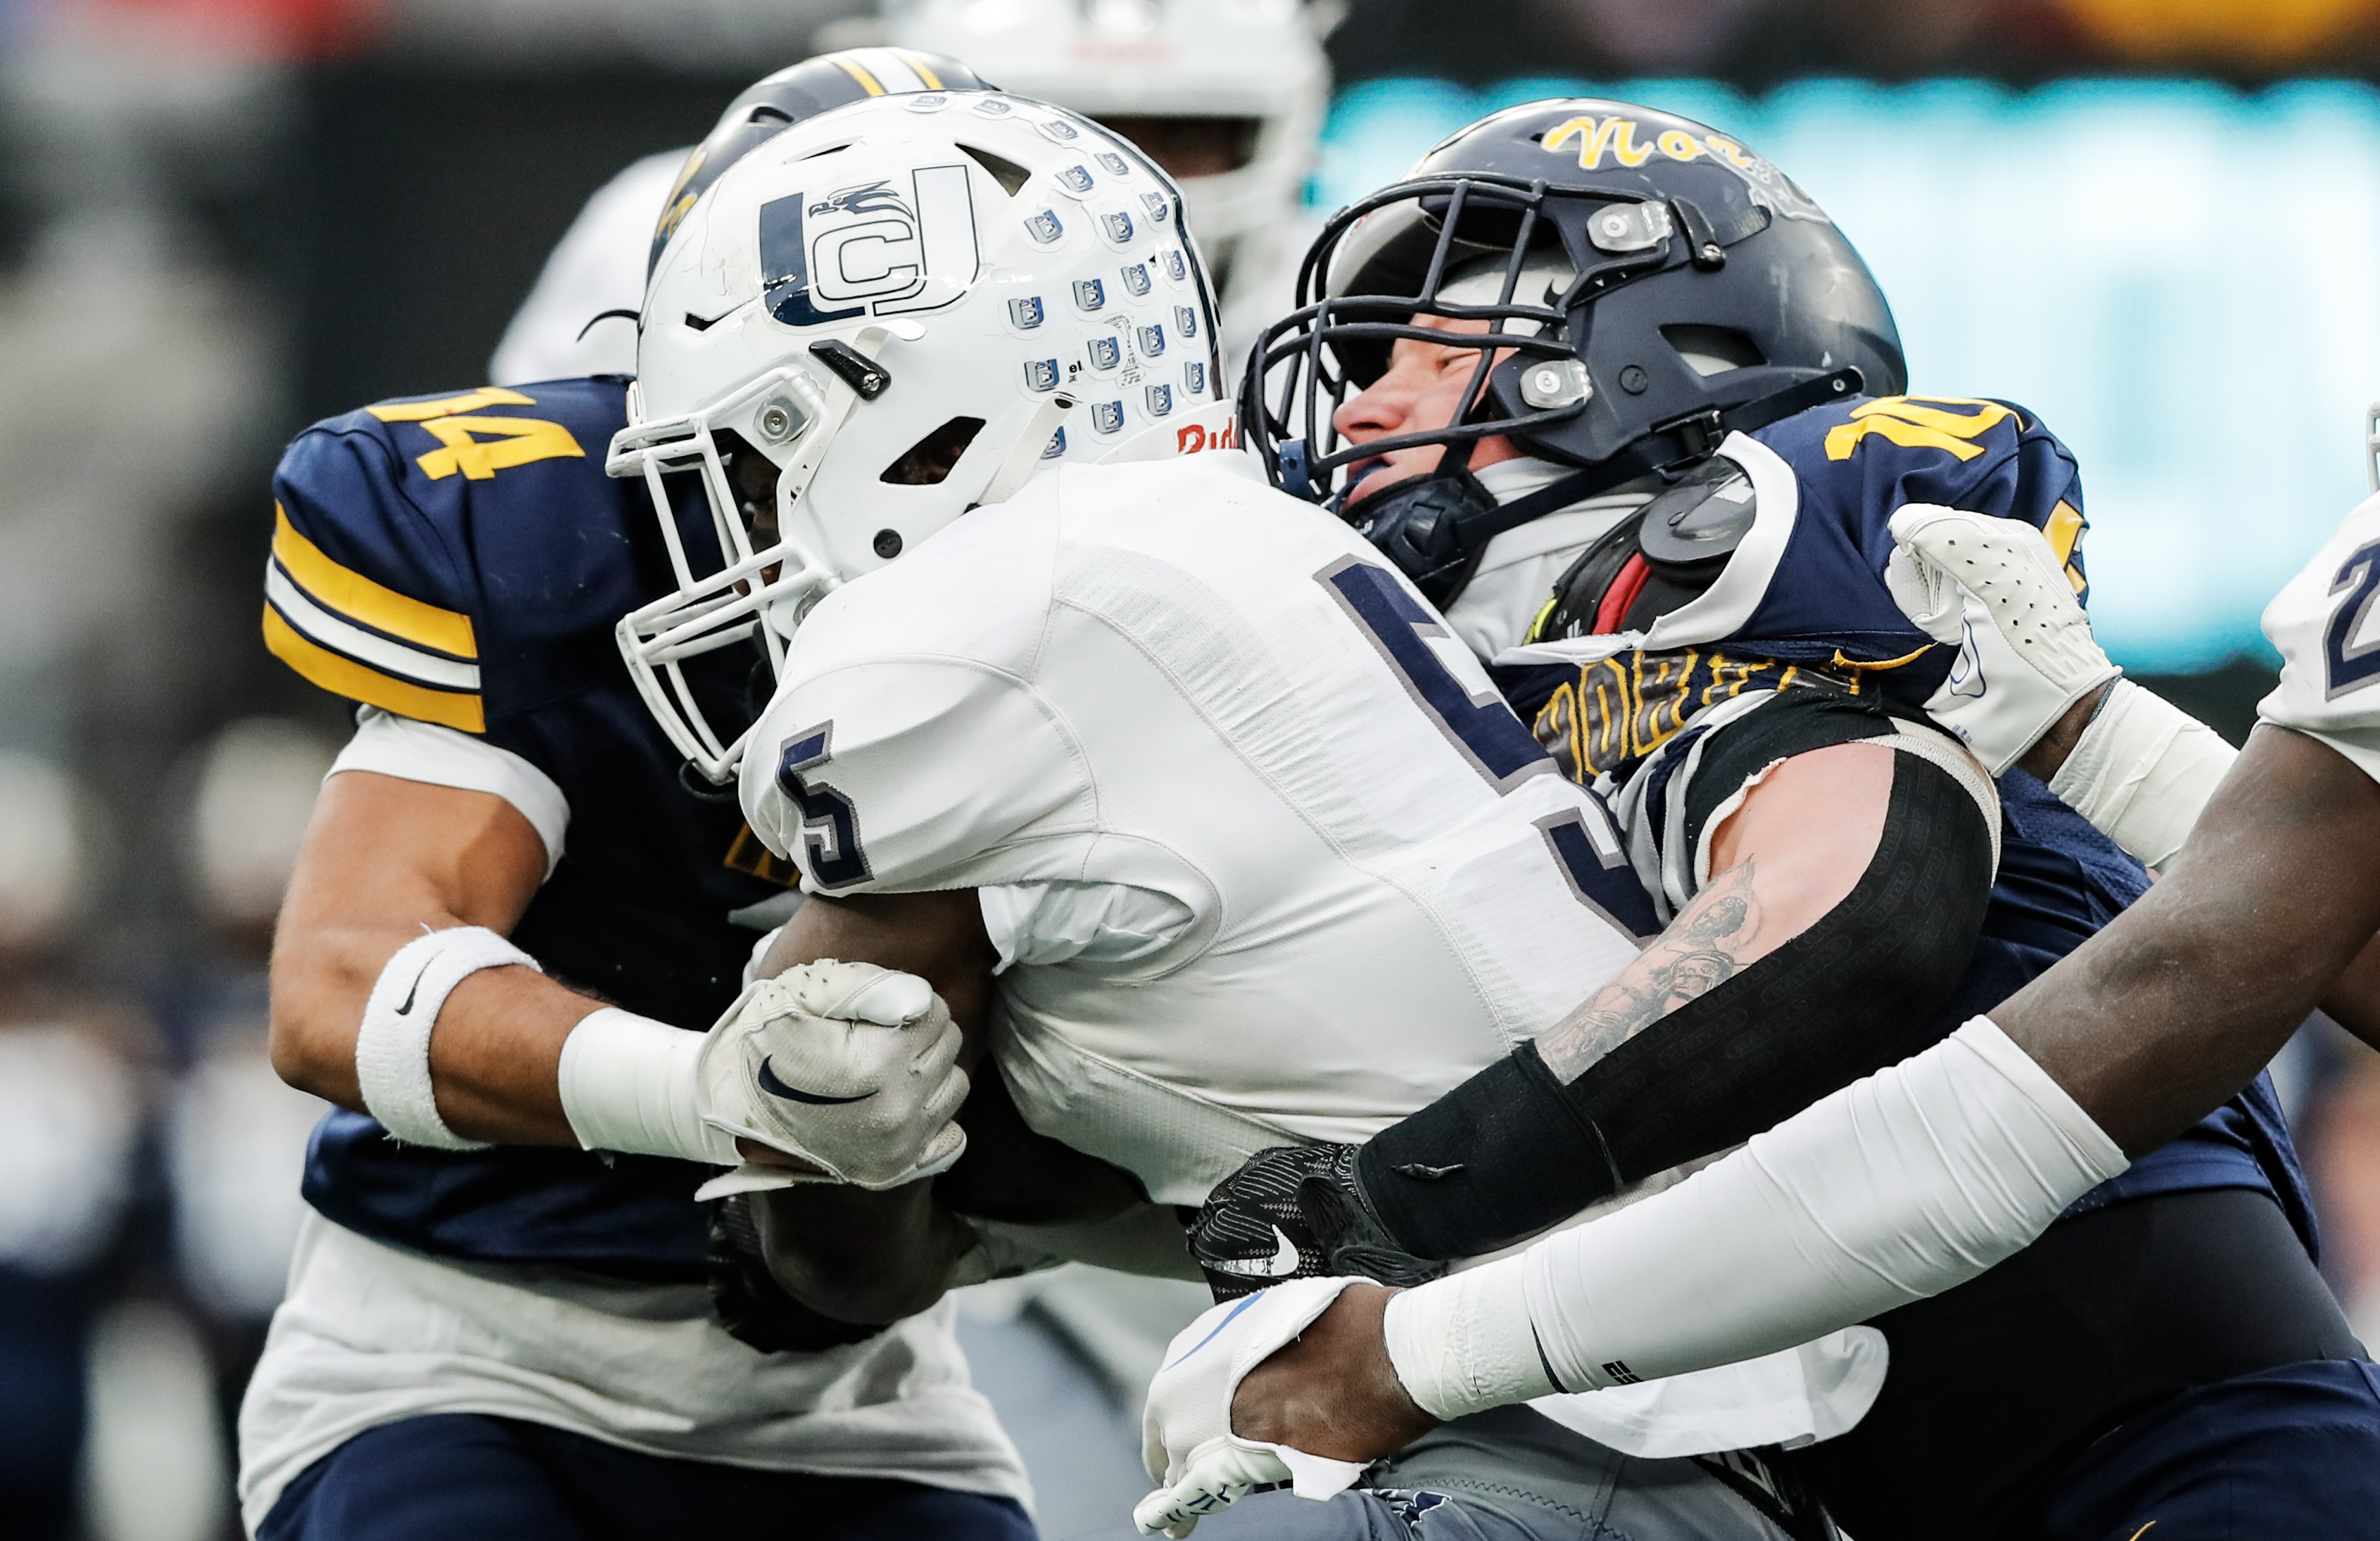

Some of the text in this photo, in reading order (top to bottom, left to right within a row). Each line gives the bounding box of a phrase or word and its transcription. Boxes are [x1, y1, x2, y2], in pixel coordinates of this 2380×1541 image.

[366, 386, 585, 481] 14
[1823, 395, 2024, 462] 10
[775, 718, 875, 890] 5
